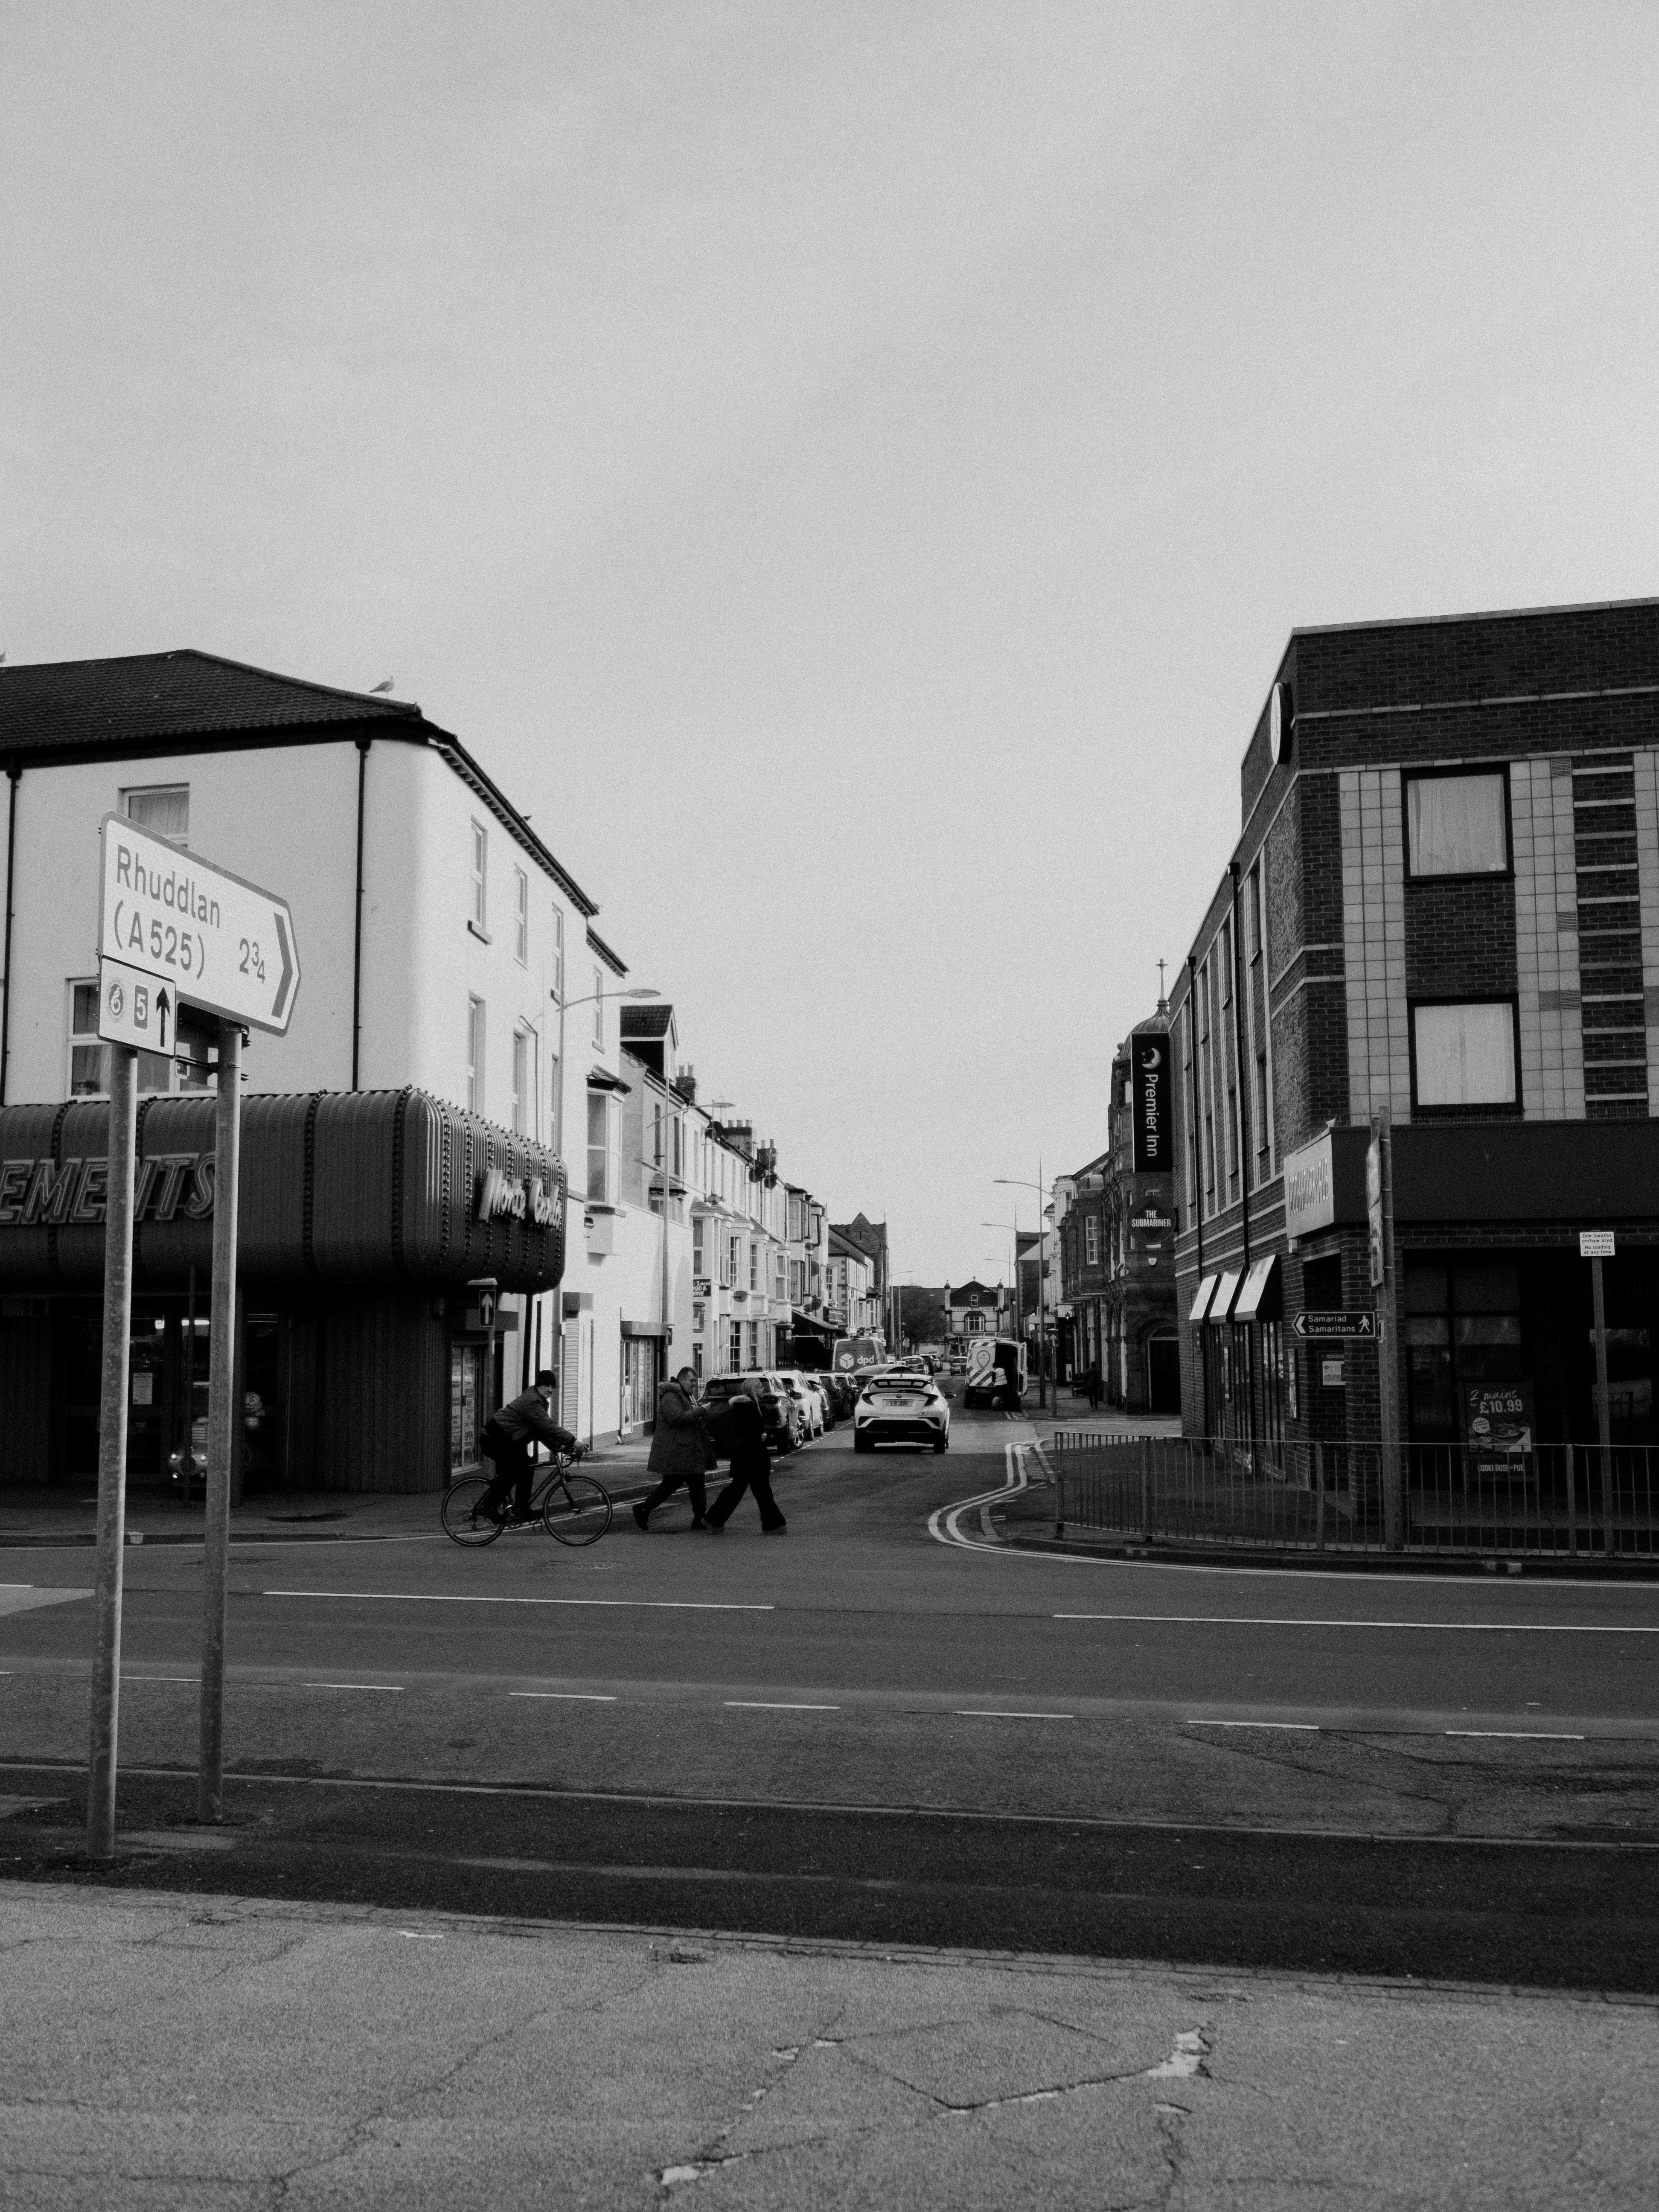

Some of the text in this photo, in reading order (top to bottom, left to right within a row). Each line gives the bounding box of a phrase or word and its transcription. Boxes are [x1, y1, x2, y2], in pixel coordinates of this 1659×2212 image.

[117, 844, 220, 928] Rhuddlan
[136, 993, 146, 1021] 5
[1145, 1074, 1160, 1156] Premier Inn
[1145, 1210, 1157, 1218] THE
[1132, 1219, 1171, 1227] SUBMARINER
[857, 1355, 874, 1365] dpd
[1470, 1389, 1516, 1401] 2 mains
[1479, 1399, 1523, 1414] £10.99
